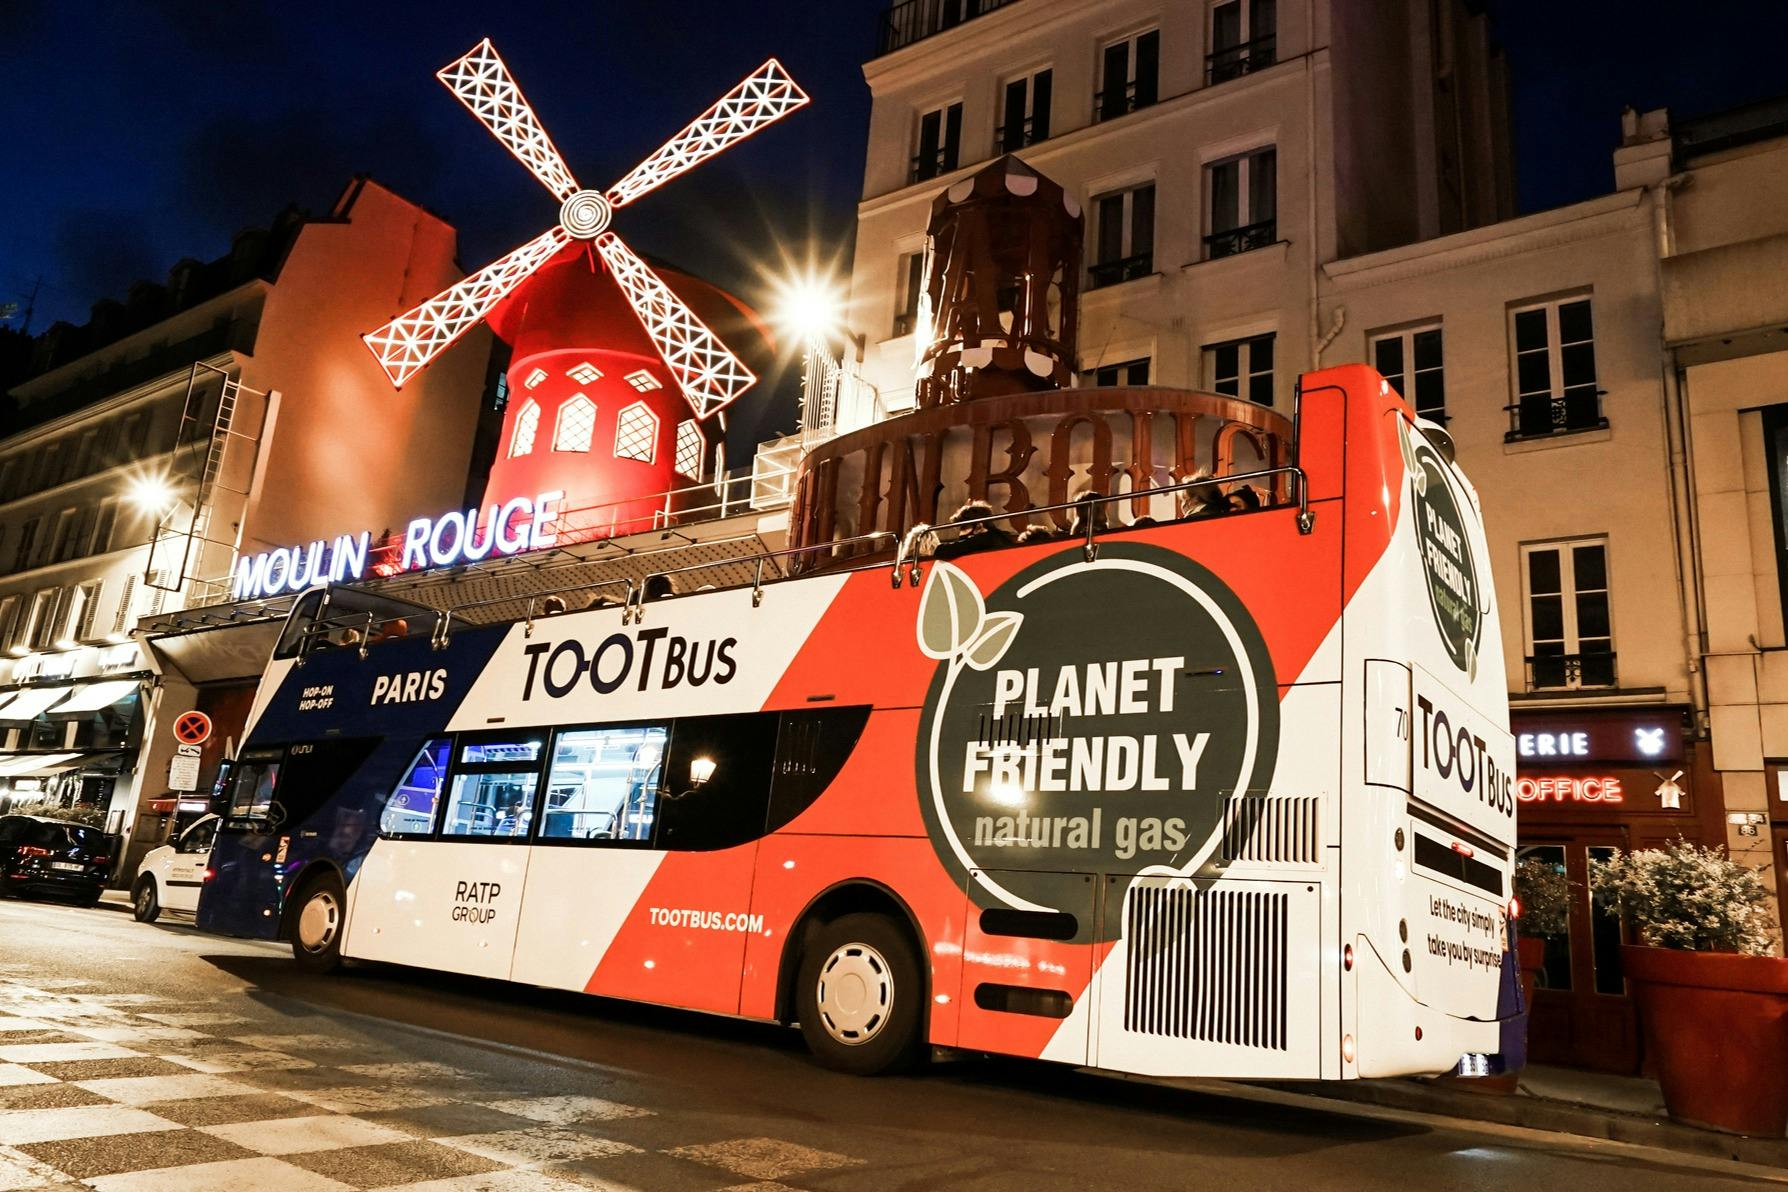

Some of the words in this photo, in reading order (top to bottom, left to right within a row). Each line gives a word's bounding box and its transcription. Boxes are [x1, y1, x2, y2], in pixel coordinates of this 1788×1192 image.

[232, 530, 372, 601] MOULIN
[401, 490, 566, 571] ROUGE
[1424, 501, 1463, 565] PLANET
[1424, 536, 1472, 607] FRIENDLY
[298, 697, 334, 711] HOP-OFF
[302, 685, 334, 698] HOP-ON
[370, 668, 448, 706] PARIS
[993, 656, 1185, 720] PLANET
[962, 732, 1211, 793] FRIENDLY
[1519, 732, 1589, 756] ERIE
[1517, 778, 1623, 802] OFFICE
[974, 807, 1102, 849] natural
[1115, 816, 1186, 860] gas
[455, 880, 501, 904] RATP
[451, 906, 496, 925] GROUP
[649, 907, 763, 933] TOOTBUS.COM
[1429, 894, 1442, 918] Let
[1443, 898, 1456, 922] the
[1457, 902, 1471, 933] city
[1471, 907, 1495, 940] simply
[1427, 933, 1446, 958] take
[1447, 941, 1462, 966] you
[1462, 940, 1473, 970] by
[1473, 946, 1501, 973] surprise
